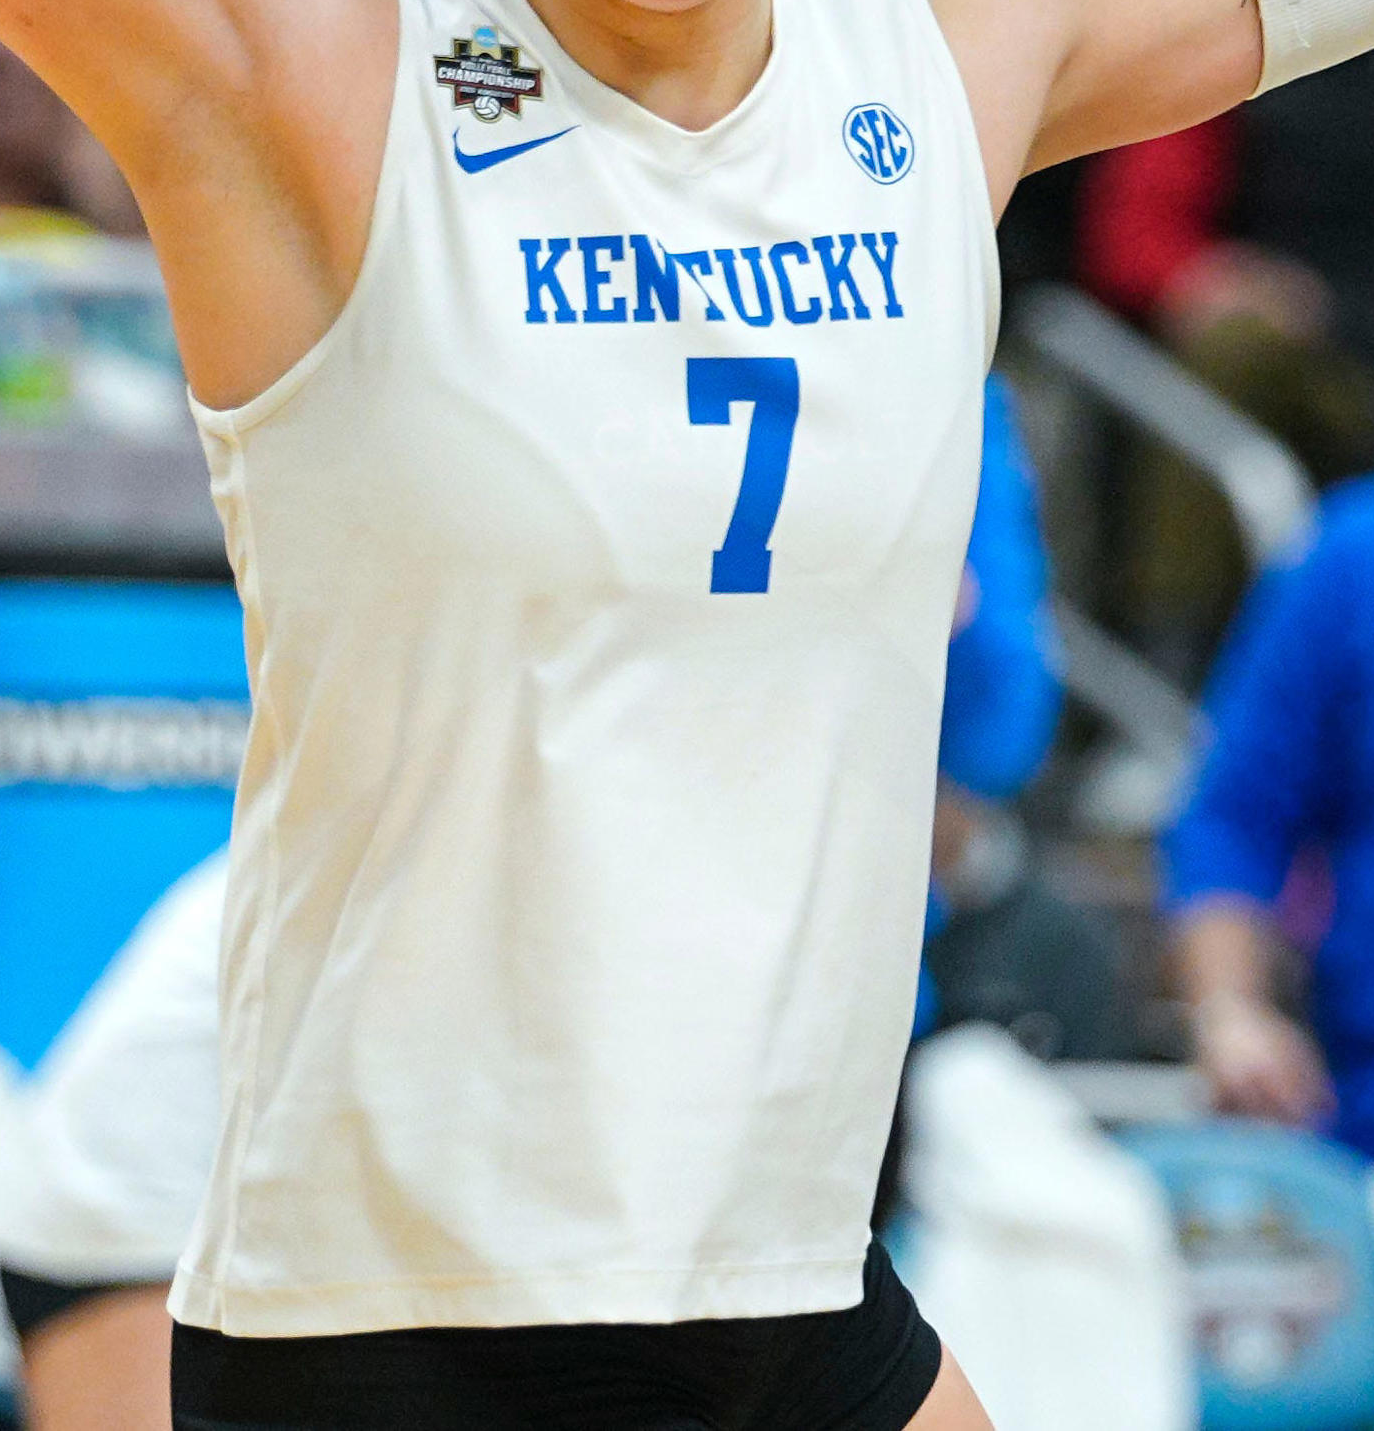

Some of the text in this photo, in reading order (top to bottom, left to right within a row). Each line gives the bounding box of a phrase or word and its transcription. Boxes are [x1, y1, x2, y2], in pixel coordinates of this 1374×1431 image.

[437, 67, 536, 91] CHAMPIONSHIP
[850, 109, 907, 178] SEC
[519, 232, 904, 327] KENTUCKY
[686, 357, 800, 594] 7
